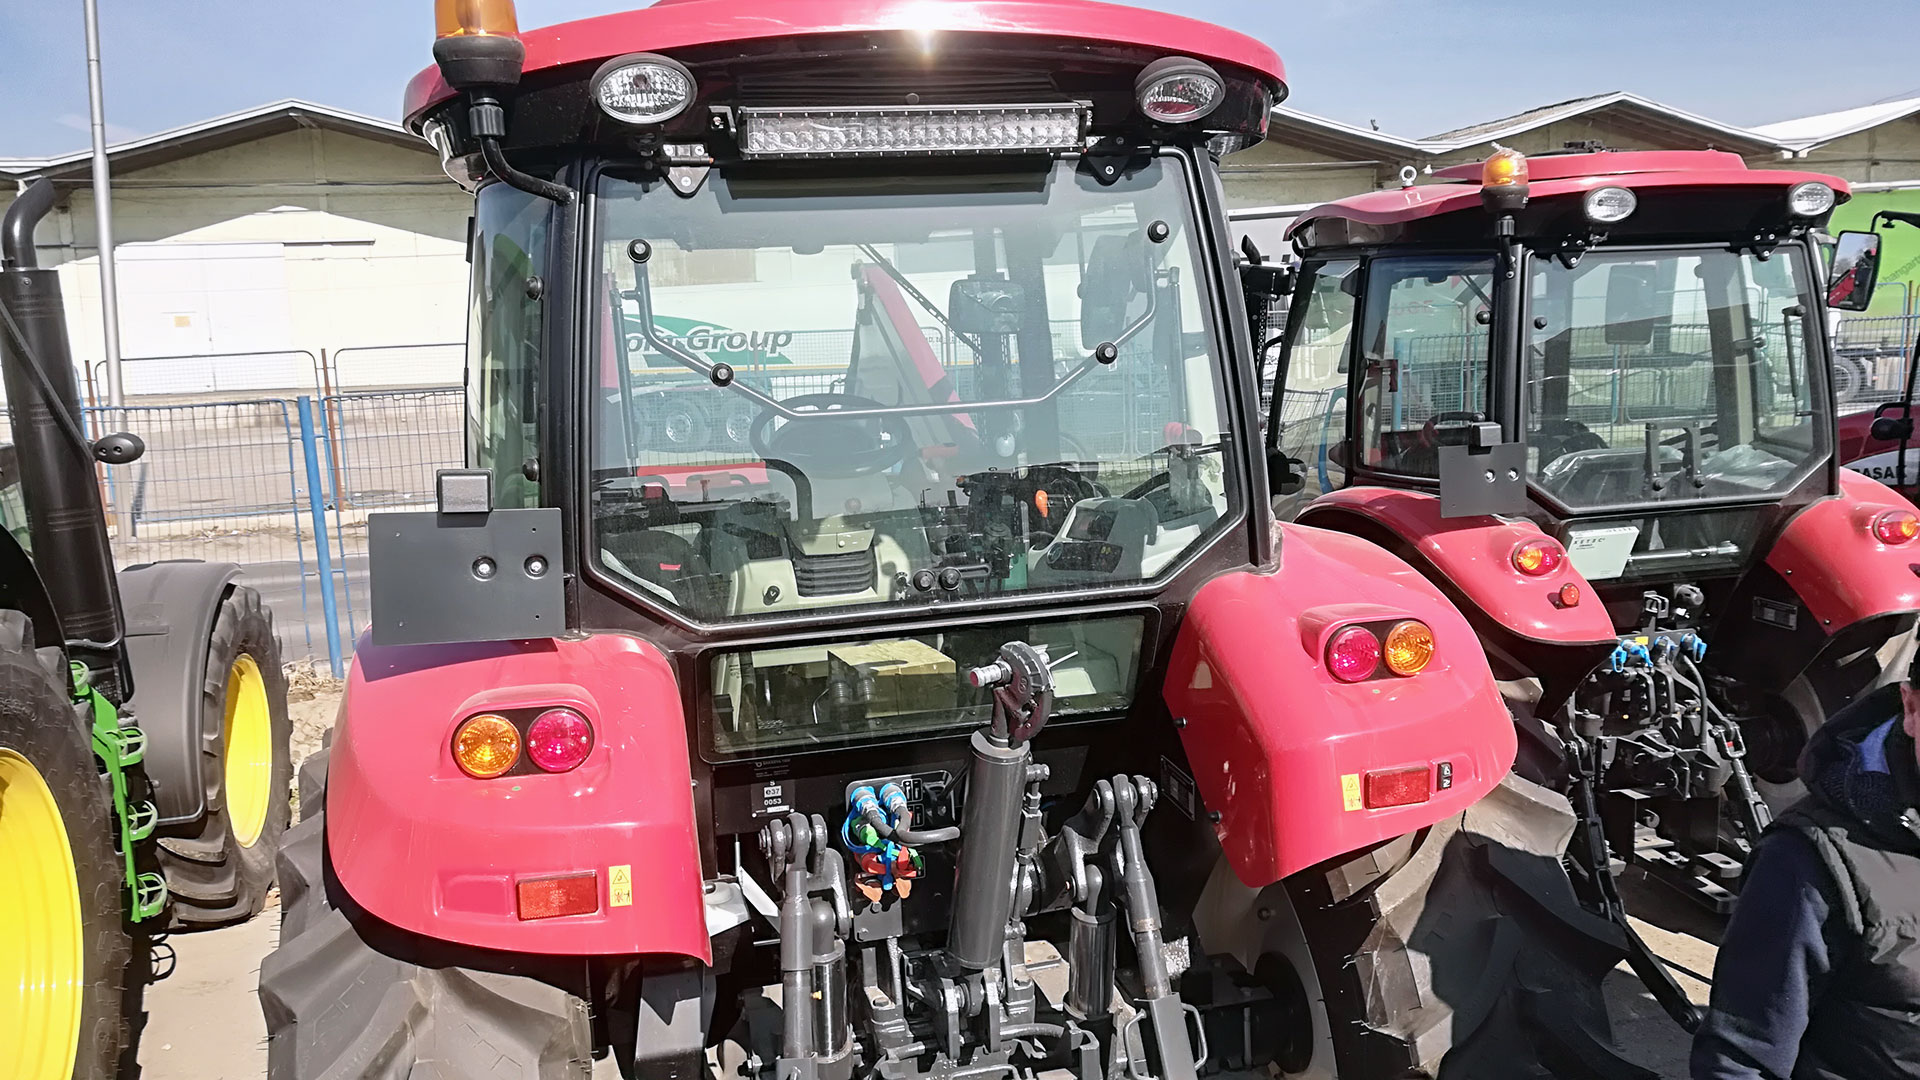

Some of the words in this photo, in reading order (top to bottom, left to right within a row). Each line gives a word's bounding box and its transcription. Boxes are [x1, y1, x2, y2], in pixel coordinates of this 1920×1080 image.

[687, 327, 793, 355] Group
[1851, 466, 1907, 480] ASAK
[765, 788, 781, 796] e37
[763, 798, 782, 806] 0053
